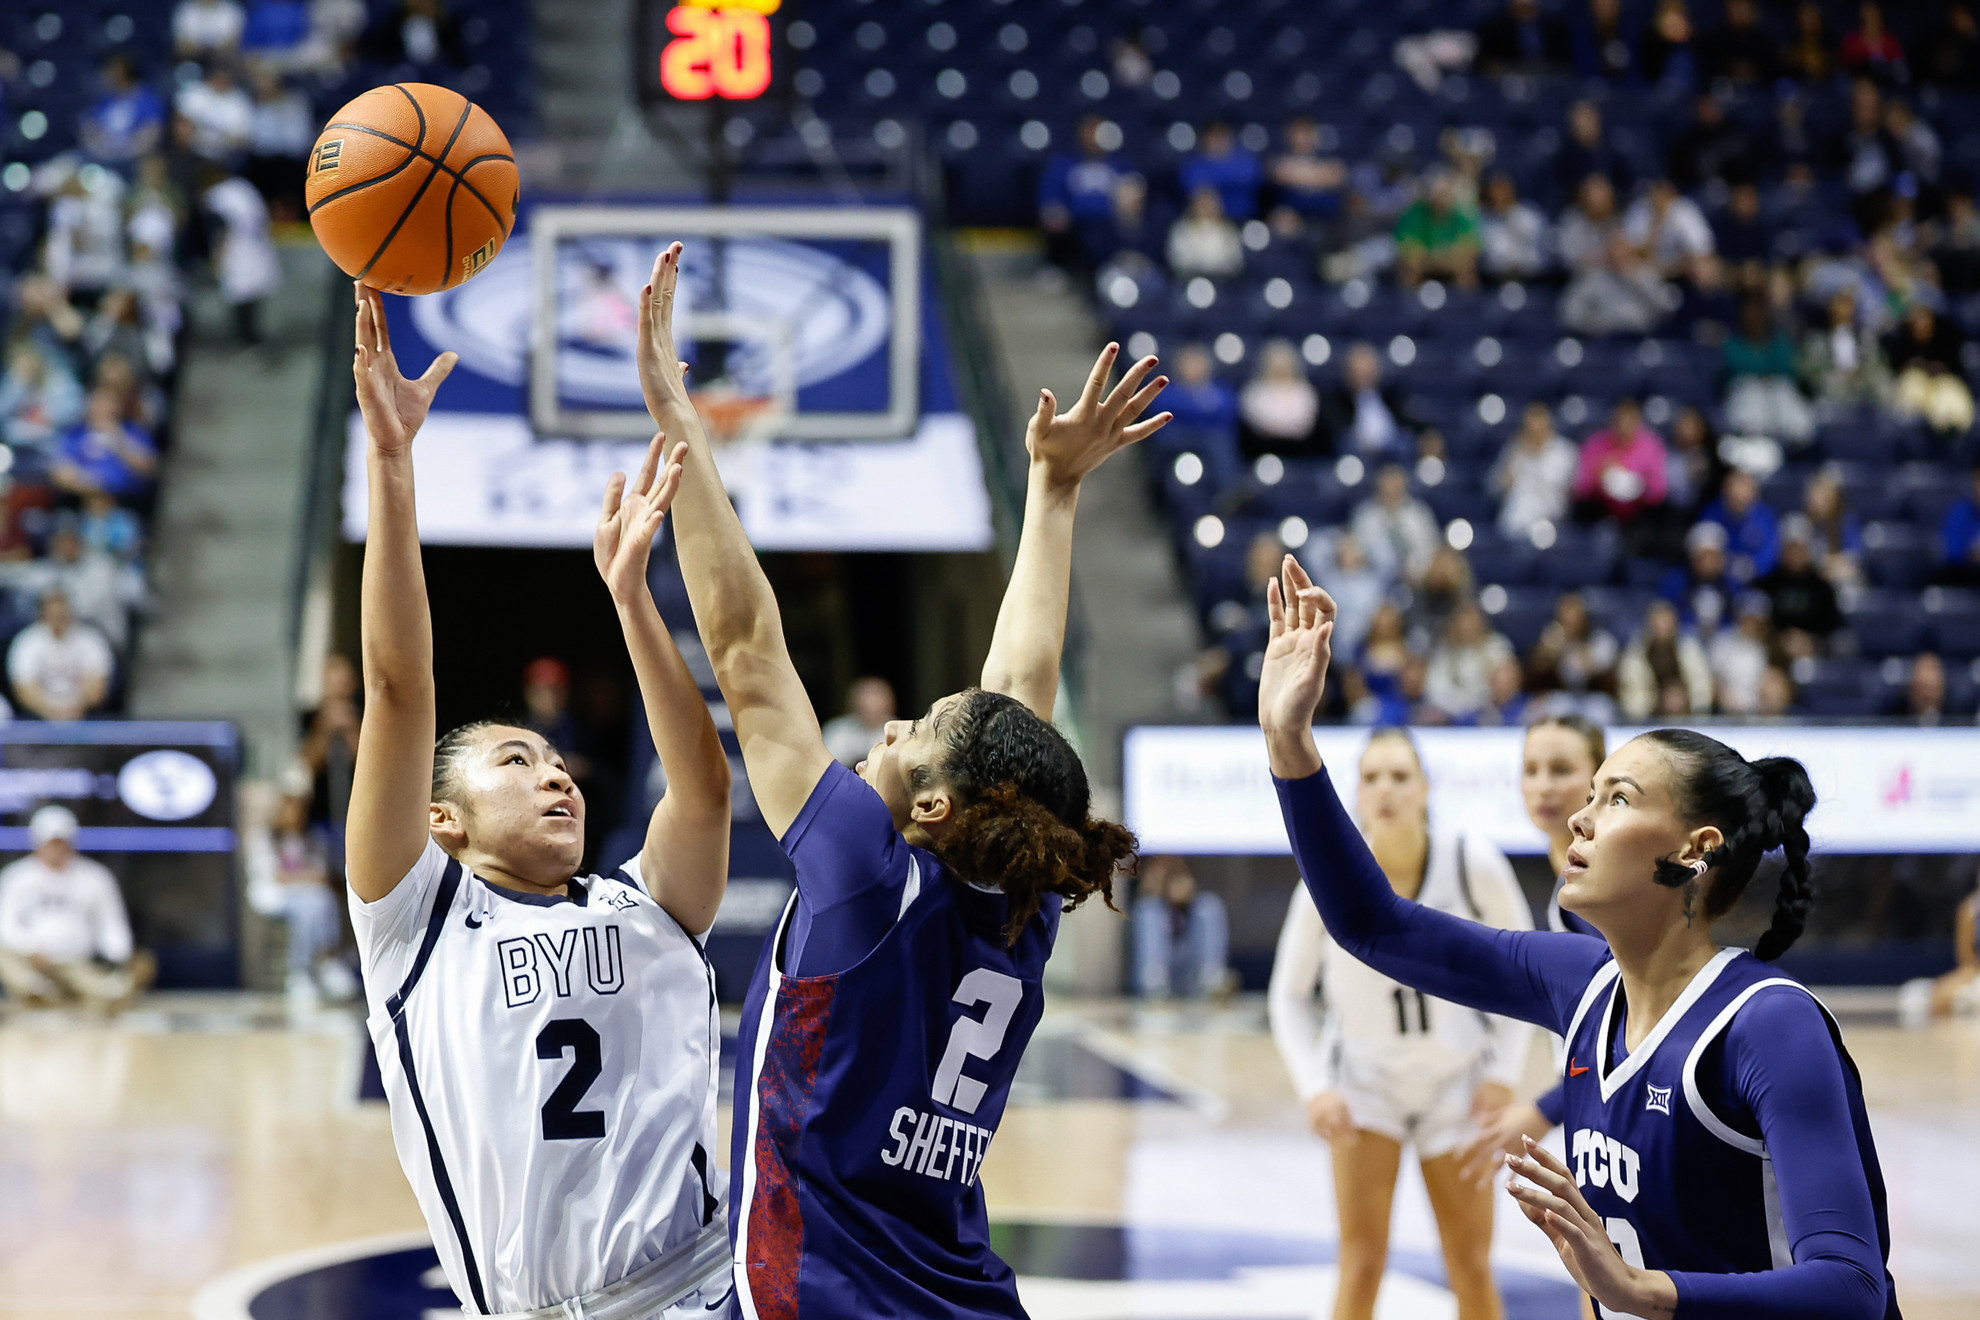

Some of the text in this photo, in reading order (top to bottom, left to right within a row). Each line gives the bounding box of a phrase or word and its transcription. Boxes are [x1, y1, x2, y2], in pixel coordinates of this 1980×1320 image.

[661, 6, 772, 99] 20
[497, 925, 625, 1008] BYU
[1393, 986, 1430, 1034] 11
[535, 1018, 606, 1141] 2
[931, 966, 1023, 1115] 2
[1572, 1128, 1641, 1204] TCU
